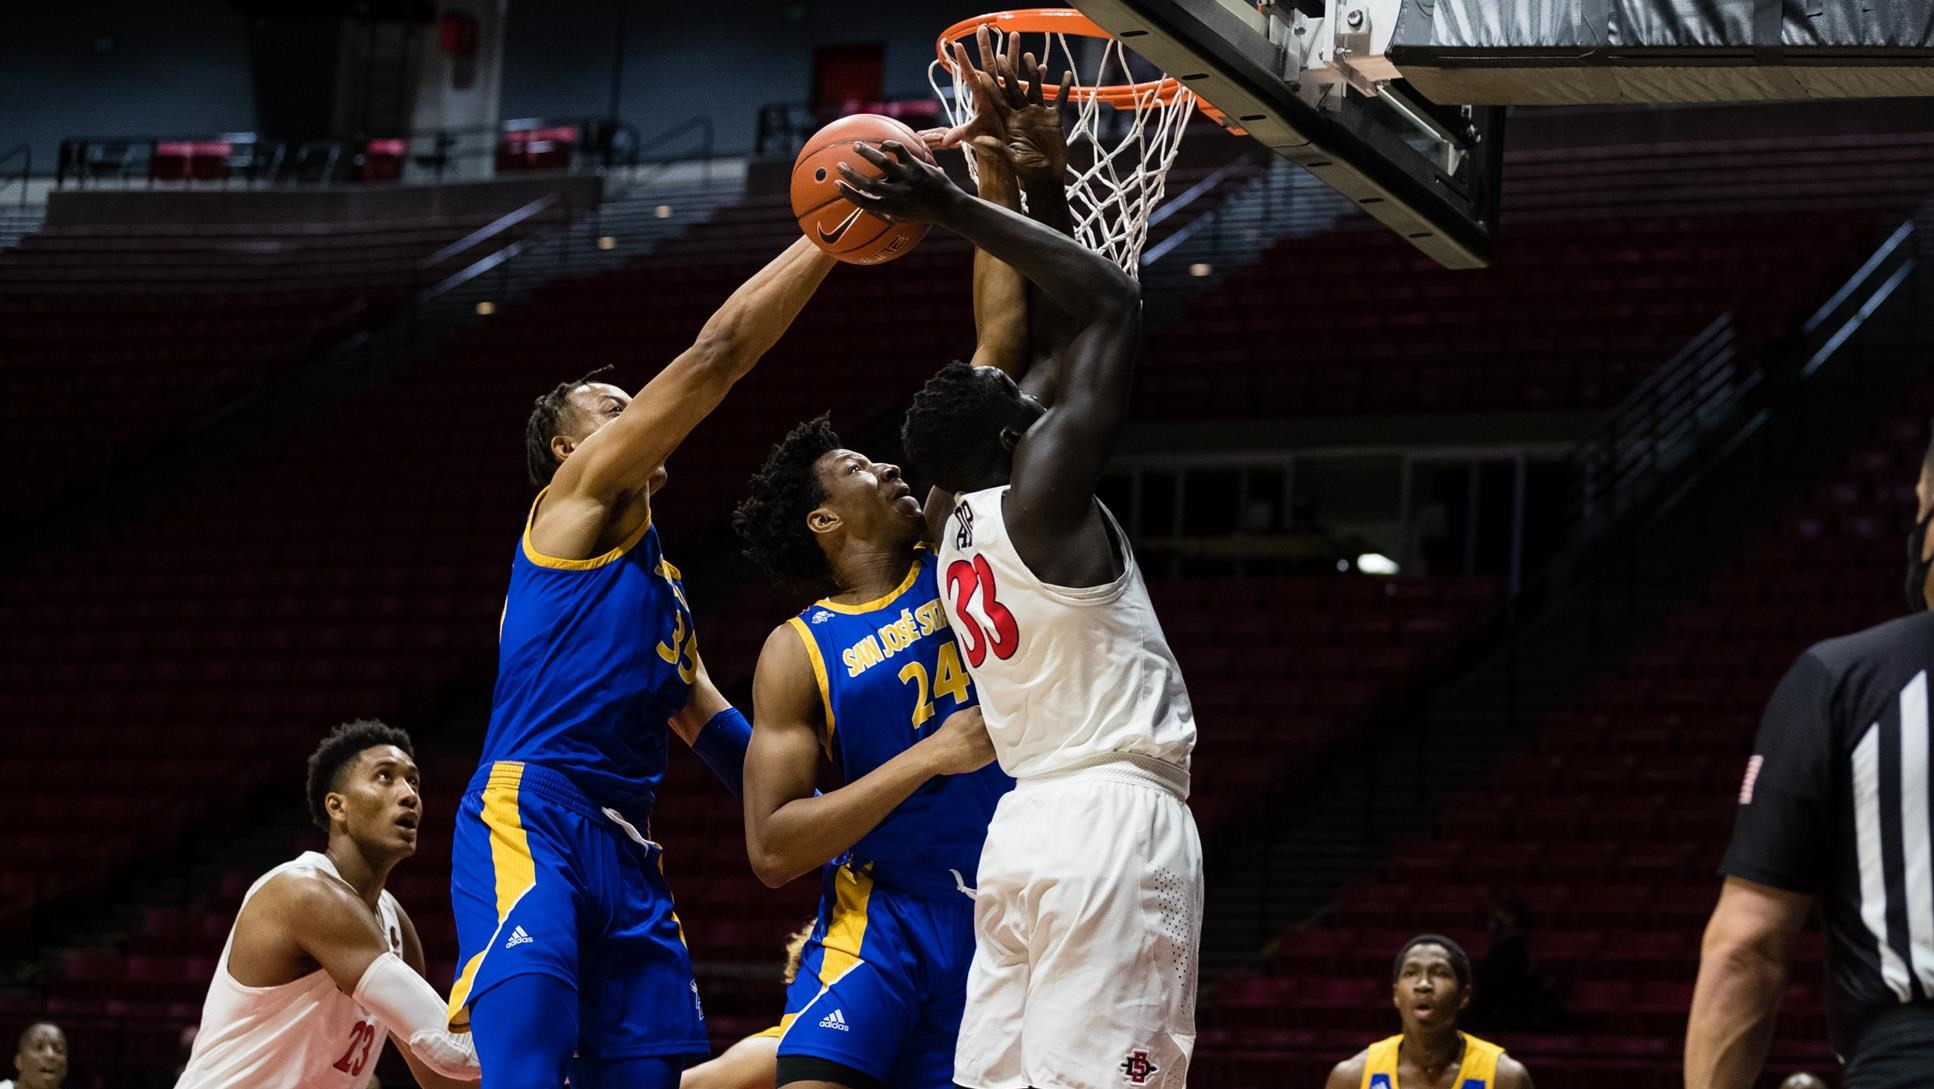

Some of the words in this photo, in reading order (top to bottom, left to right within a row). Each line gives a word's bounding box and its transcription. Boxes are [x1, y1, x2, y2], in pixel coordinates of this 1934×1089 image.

[946, 552, 1019, 668] 33
[842, 634, 885, 678] SAN
[877, 607, 922, 658] JOSÉ
[897, 640, 970, 730] 24
[505, 936, 534, 949] adidas
[332, 1020, 375, 1077] 23
[818, 1020, 849, 1032] adidas
